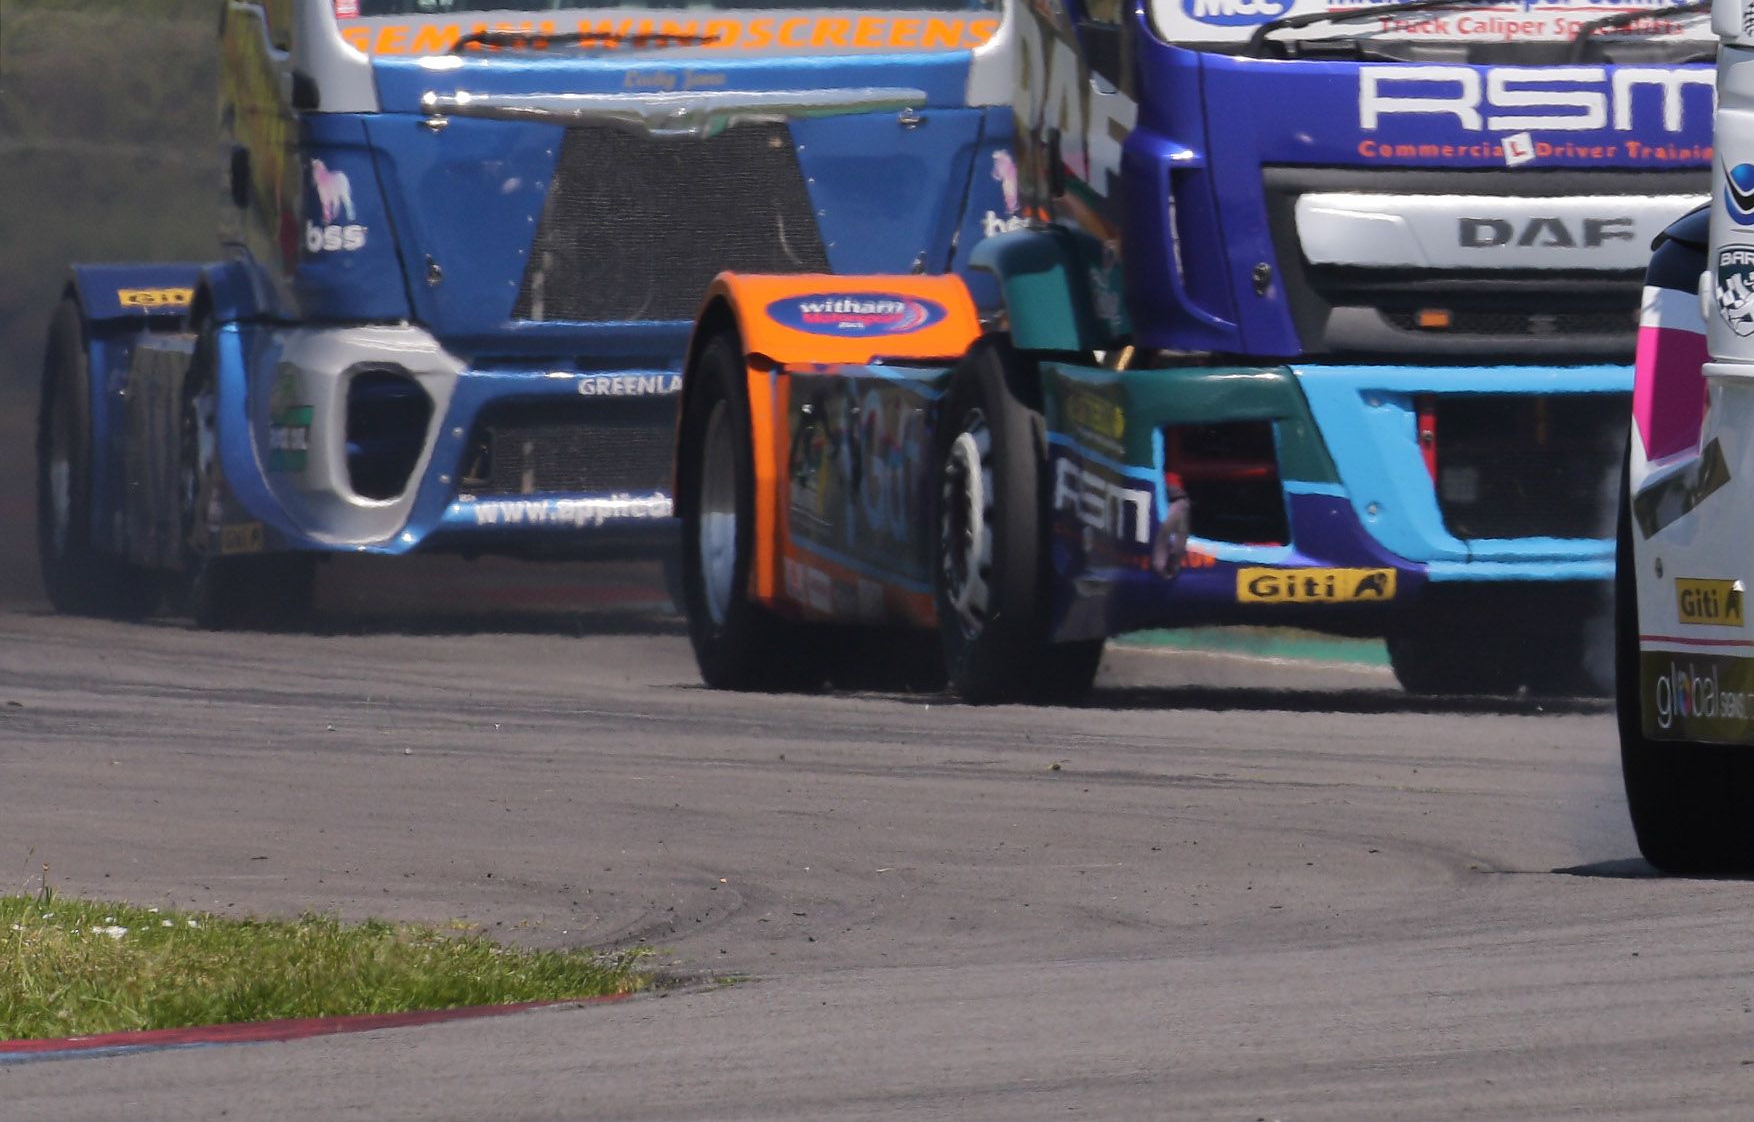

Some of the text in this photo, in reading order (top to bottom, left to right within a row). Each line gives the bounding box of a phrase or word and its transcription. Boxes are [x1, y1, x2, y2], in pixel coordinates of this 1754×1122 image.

[577, 17, 999, 52] WINDSCREENS
[1378, 16, 1451, 35] Truck
[1457, 15, 1546, 42] Caliper
[1358, 140, 1505, 158] Commercia
[1535, 141, 1617, 159] Driver
[1456, 217, 1636, 249] DAF
[799, 298, 906, 314] witham
[576, 376, 683, 396] GREENLA
[1248, 575, 1335, 598] Giti
[1680, 588, 1719, 619] Giti
